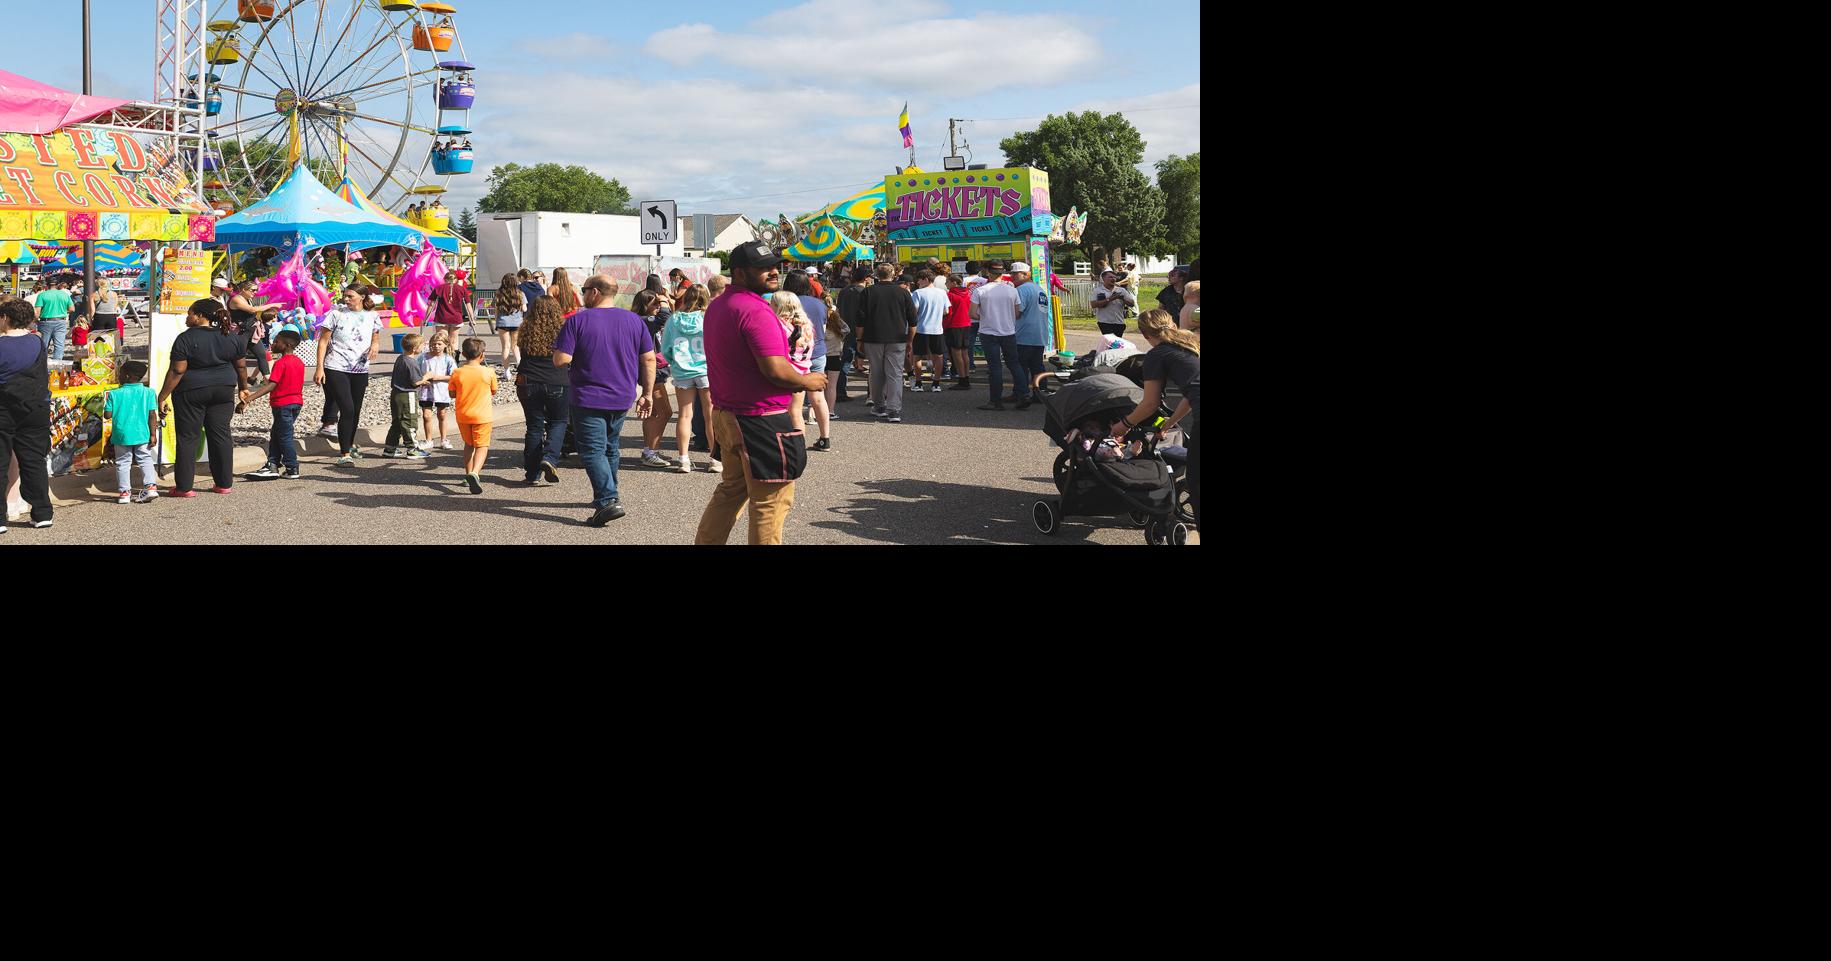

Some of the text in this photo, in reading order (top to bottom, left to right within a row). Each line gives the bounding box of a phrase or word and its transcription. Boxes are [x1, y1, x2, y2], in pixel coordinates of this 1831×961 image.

[53, 170, 178, 209] CORN
[896, 186, 1021, 221] TICKETS
[645, 232, 670, 241] ONLY
[921, 229, 942, 237] TICKET
[38, 248, 58, 258] RUN
[178, 250, 204, 258] MENU
